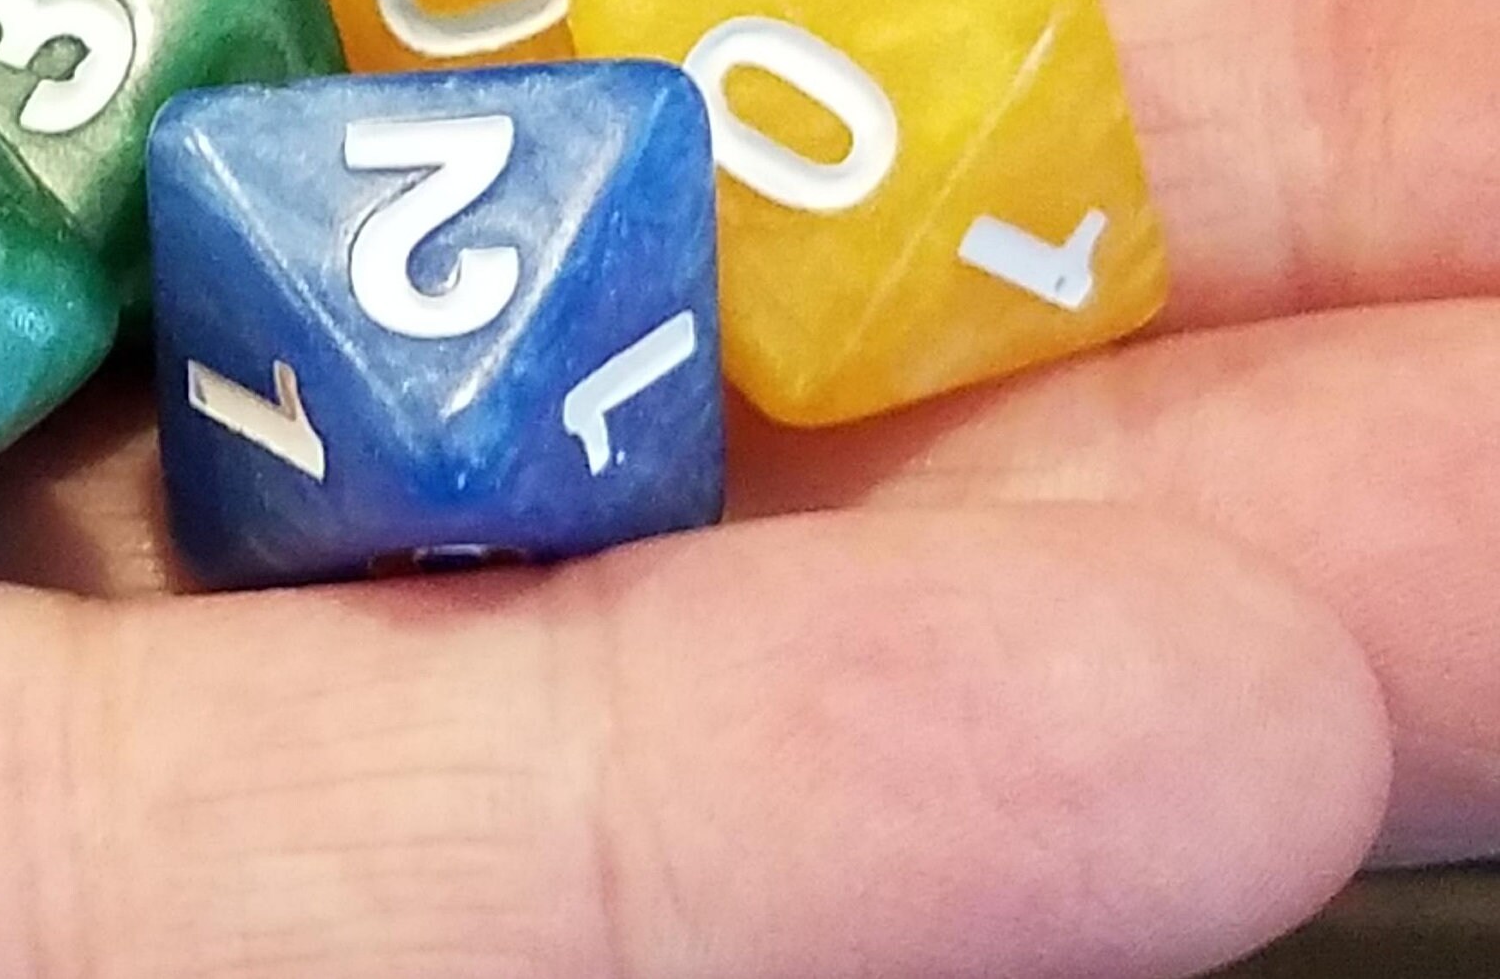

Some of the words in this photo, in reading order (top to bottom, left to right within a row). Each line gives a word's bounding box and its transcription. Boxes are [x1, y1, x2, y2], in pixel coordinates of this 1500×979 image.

[684, 16, 897, 212] 0
[345, 115, 519, 339] 2
[959, 209, 1106, 312] 1
[188, 359, 325, 483] 1
[563, 309, 695, 476] 1
